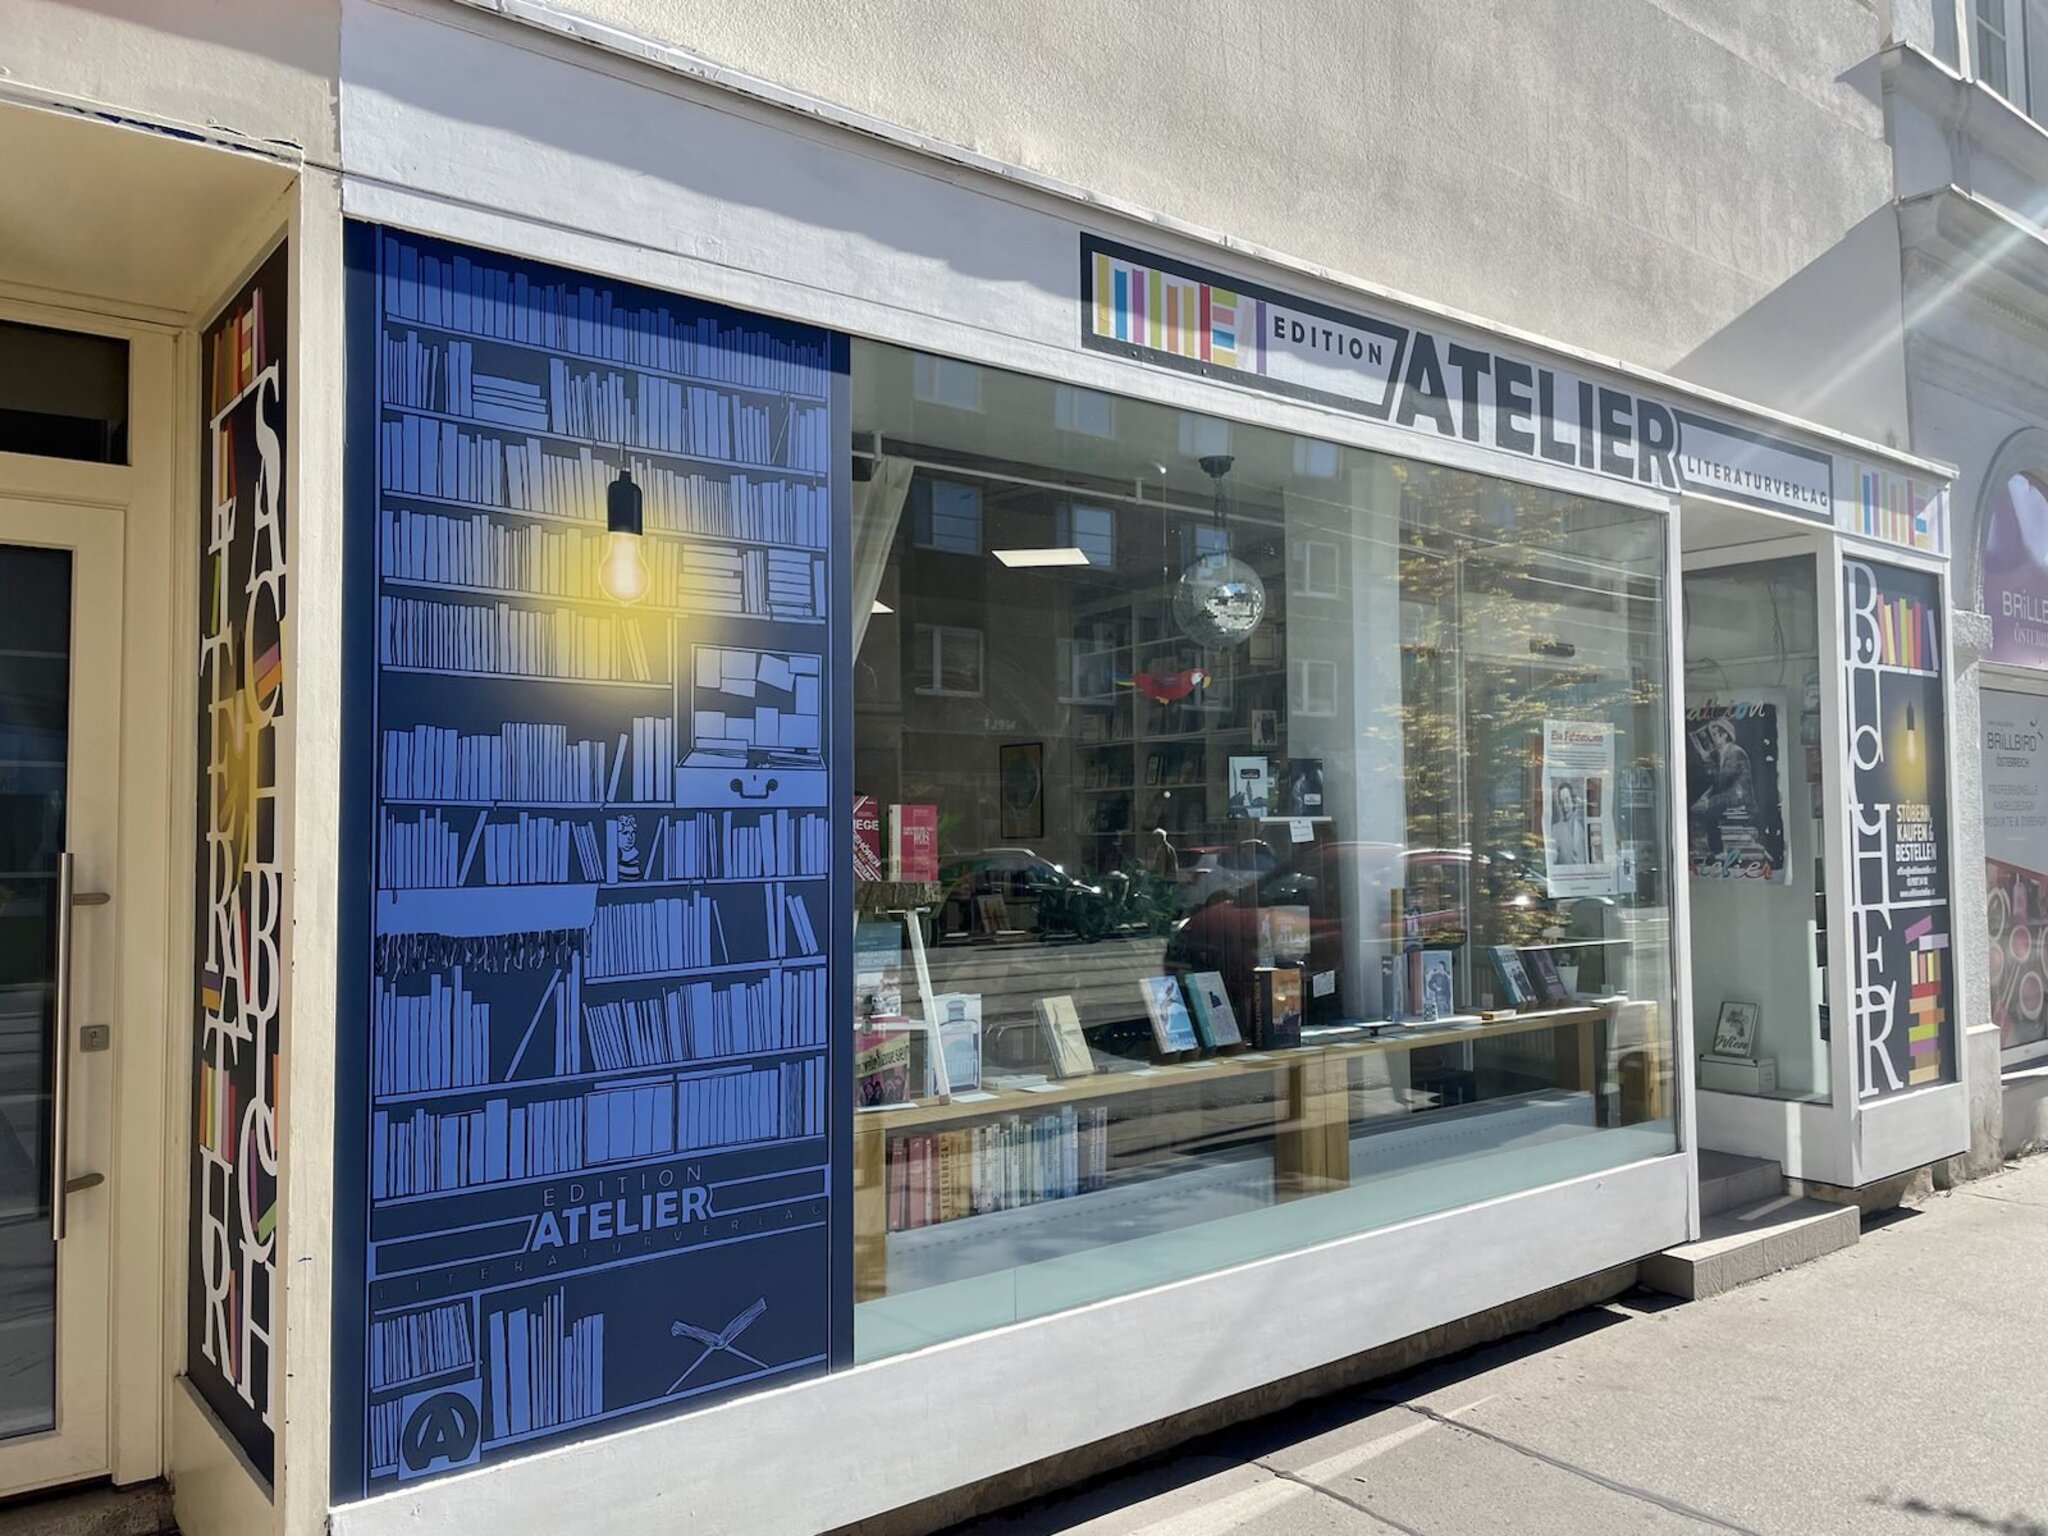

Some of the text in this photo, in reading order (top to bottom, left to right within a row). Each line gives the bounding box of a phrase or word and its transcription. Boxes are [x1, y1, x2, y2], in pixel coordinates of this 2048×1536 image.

[1274, 315, 1385, 366] EDITION
[1396, 331, 1678, 491] ATELIER
[1687, 455, 1829, 508] LITERATURVERLAG
[1685, 696, 1768, 723] dition
[1895, 842, 1938, 862] BESTELLEN
[1896, 823, 1927, 843] KAUFEN
[543, 1164, 702, 1208] EDITION
[530, 1185, 709, 1252] ATELIER
[378, 1203, 822, 1299] LITERATURVERLAG
